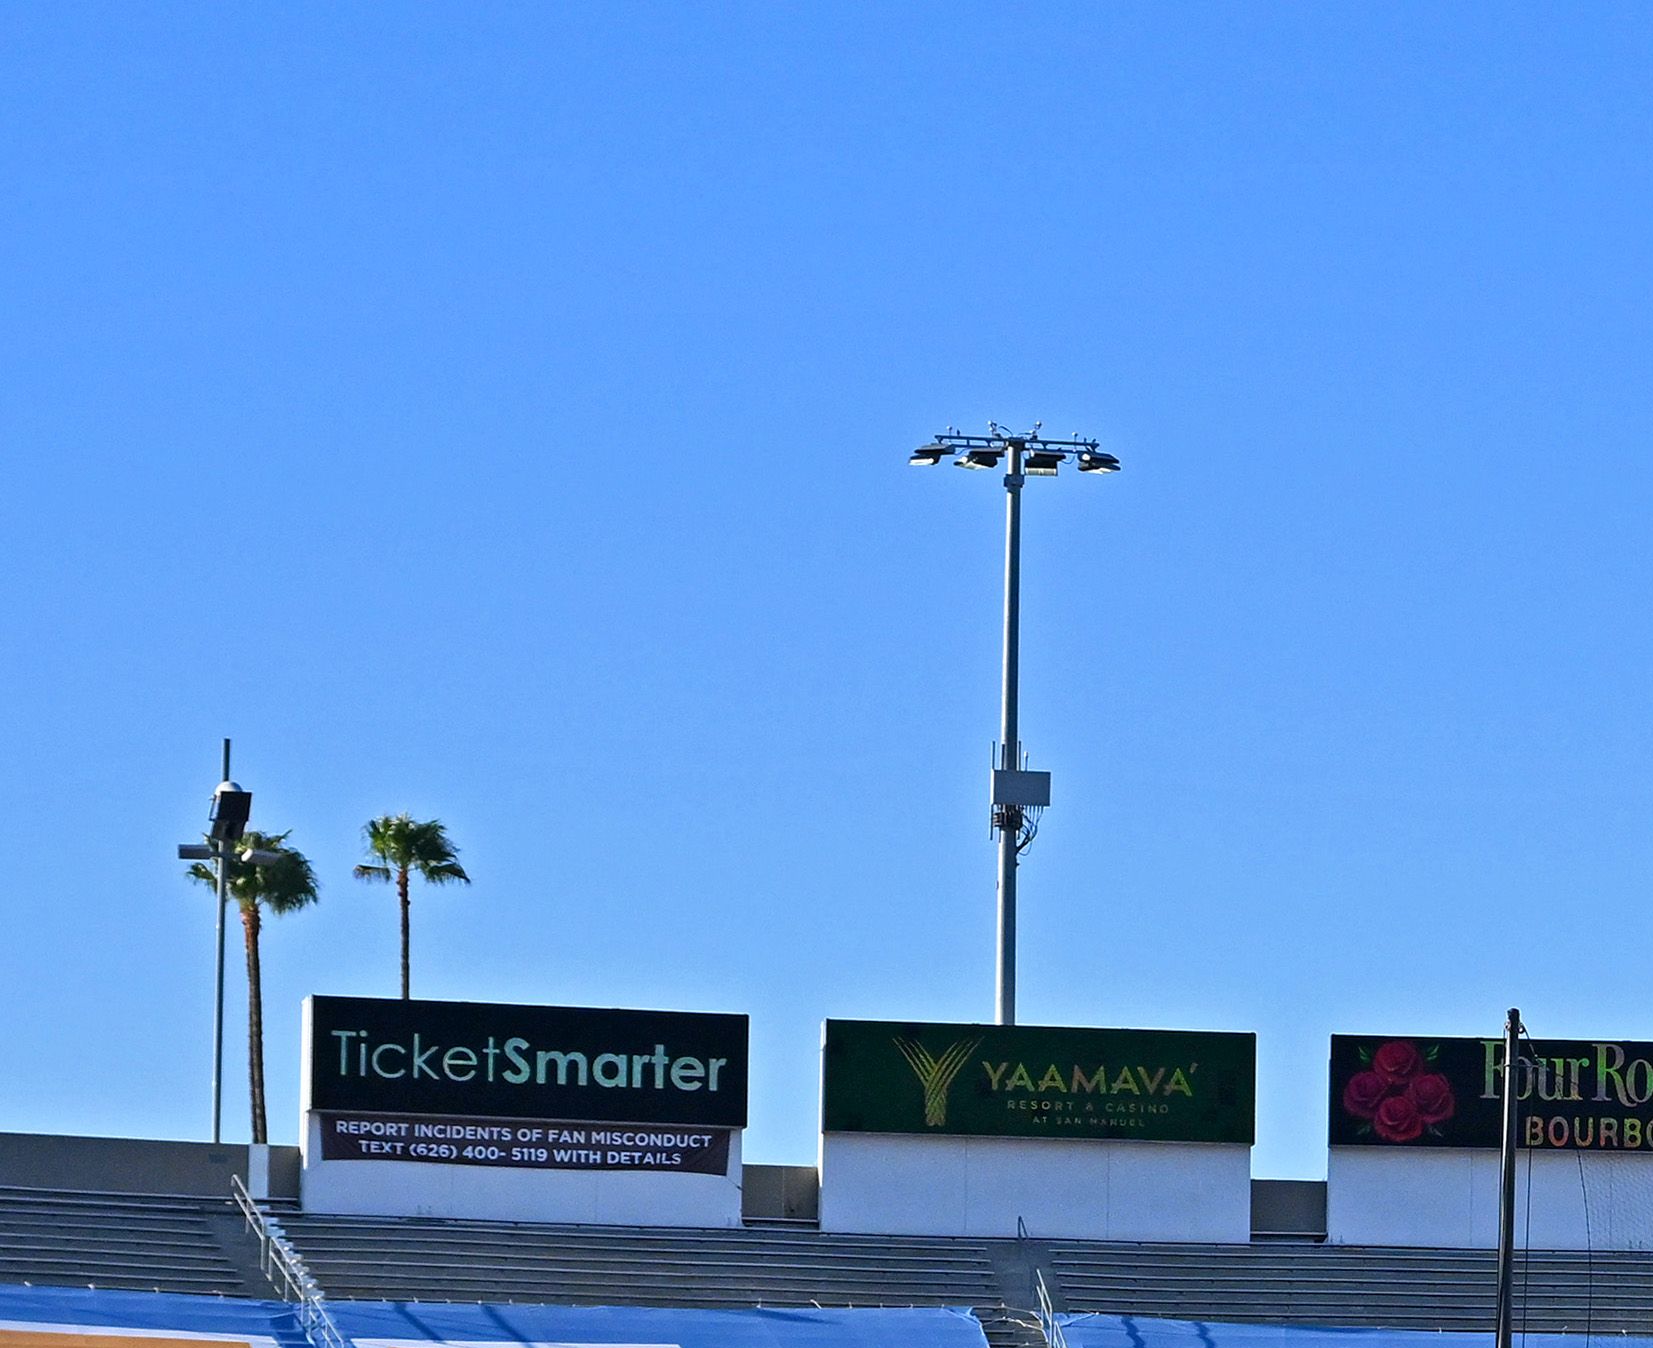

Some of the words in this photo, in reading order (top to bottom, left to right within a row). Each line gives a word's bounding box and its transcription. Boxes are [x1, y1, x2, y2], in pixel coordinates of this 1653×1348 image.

[331, 1030, 727, 1092] TicketSmarter
[1007, 1100, 1074, 1111] RESORT
[1105, 1103, 1169, 1114] CASINO
[336, 1119, 409, 1138] REPORT
[414, 1122, 511, 1142] INCIDENTS
[518, 1127, 544, 1142] OF
[548, 1127, 586, 1144] FAN
[592, 1130, 712, 1149] MISCONDUCT
[359, 1139, 402, 1155] TEXT
[409, 1140, 457, 1158] (626)
[462, 1144, 506, 1159] 400-
[511, 1146, 548, 1162] 5119
[553, 1148, 601, 1164] WITH
[607, 1150, 681, 1165] DETAILS
